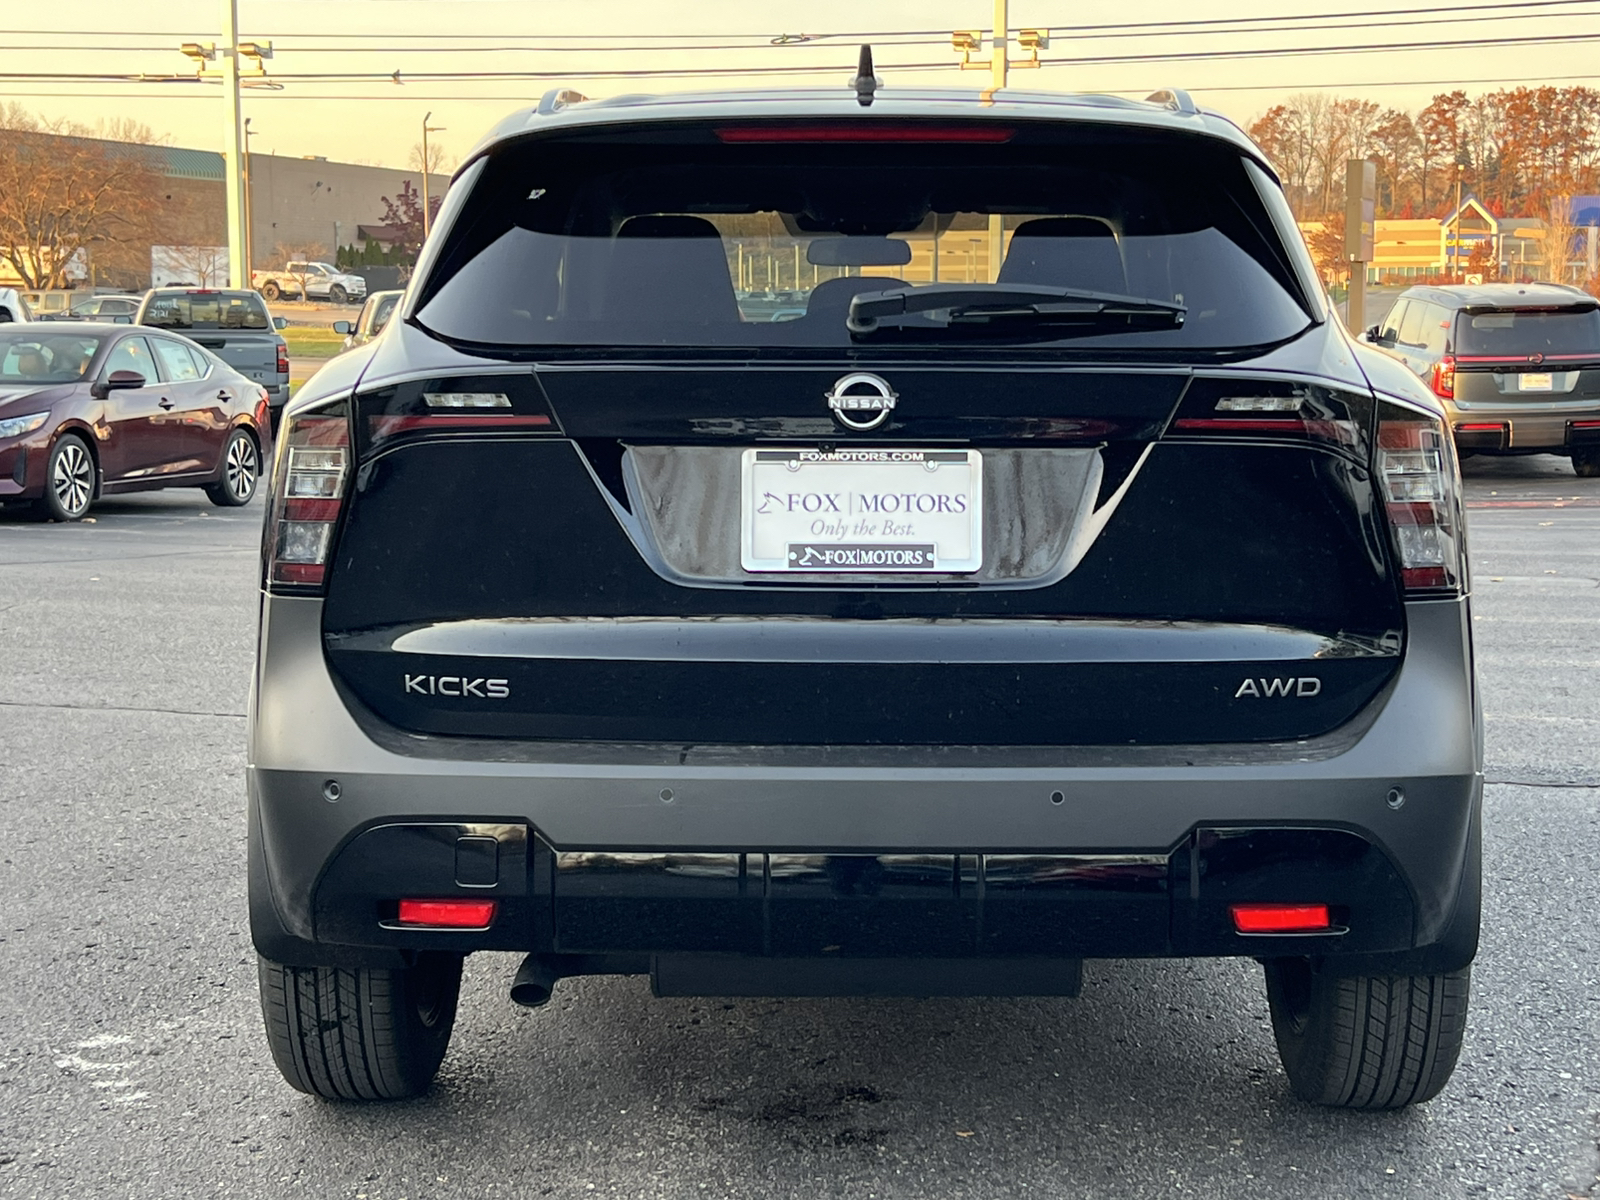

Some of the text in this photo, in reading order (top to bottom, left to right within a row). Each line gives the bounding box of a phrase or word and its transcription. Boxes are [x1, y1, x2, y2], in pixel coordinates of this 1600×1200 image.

[829, 399, 896, 409] NISSAN
[799, 452, 924, 462] FOXMOTORS.COM
[786, 493, 967, 514] FOX MOTORS
[810, 519, 916, 541] Only the Best.
[404, 673, 510, 698] KICKS
[1234, 677, 1322, 698] AWD
